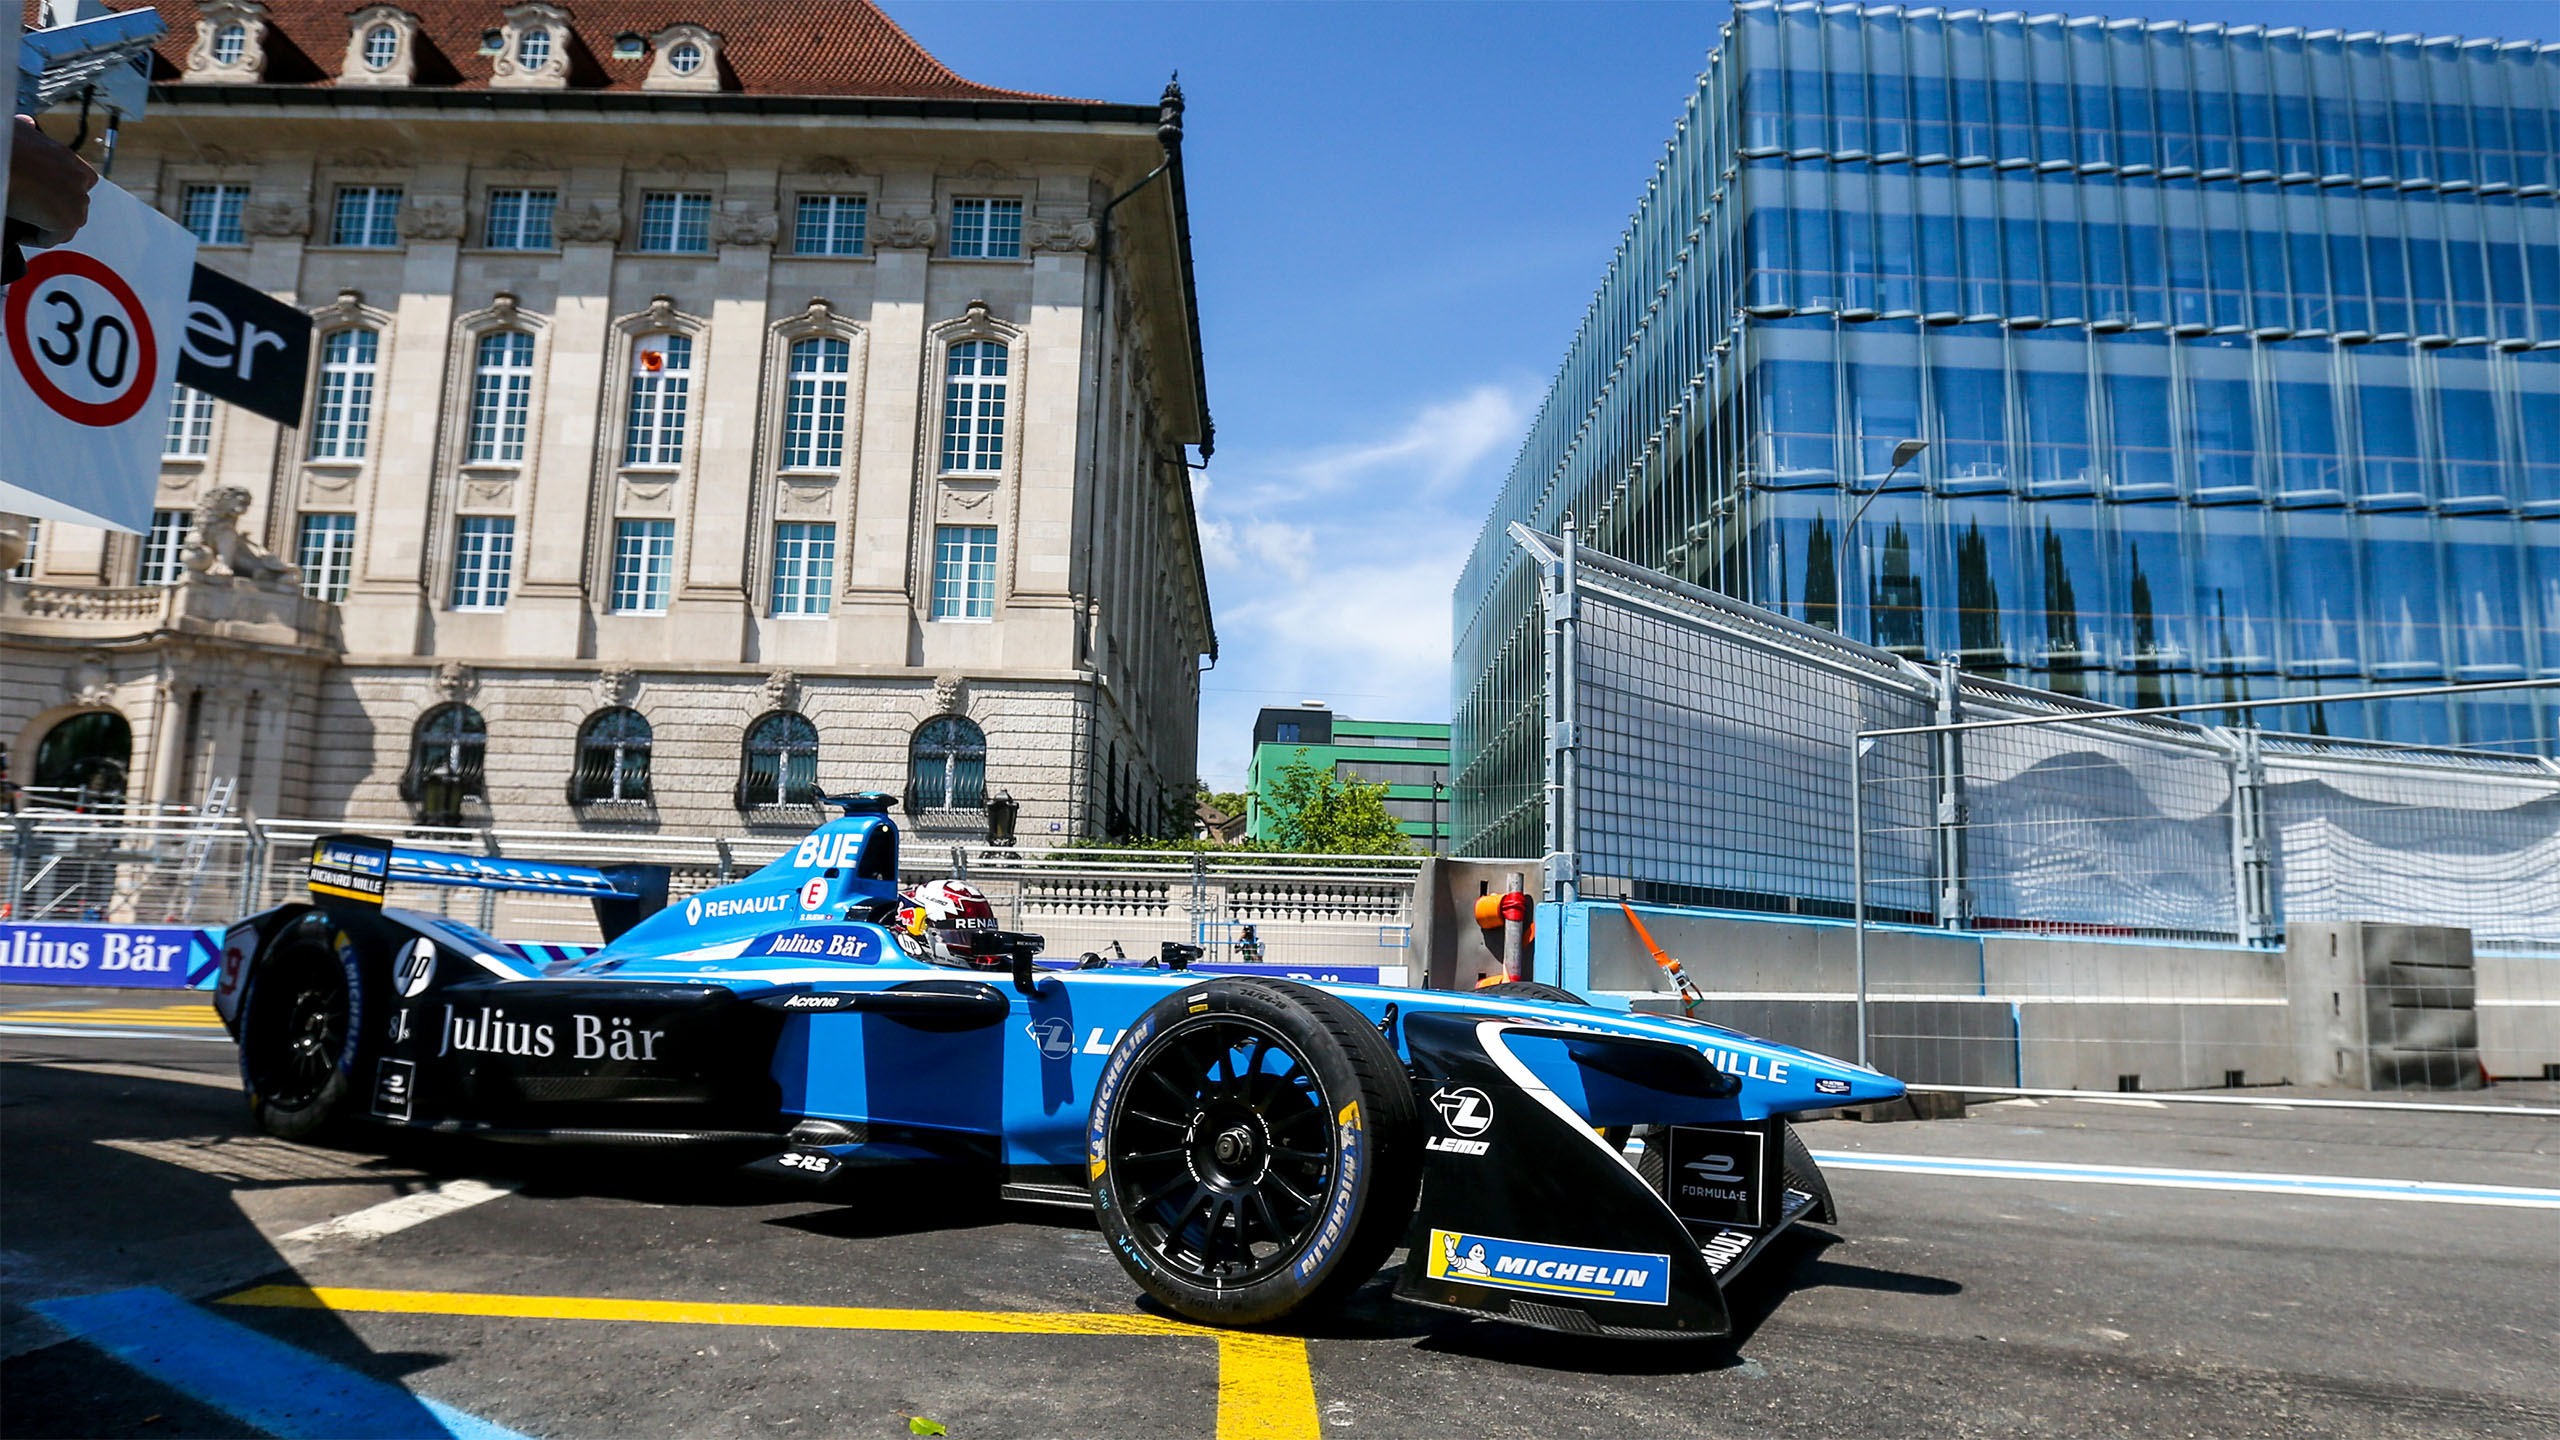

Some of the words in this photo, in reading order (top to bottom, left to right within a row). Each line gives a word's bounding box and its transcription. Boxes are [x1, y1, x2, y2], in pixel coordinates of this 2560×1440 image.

[37, 290, 129, 388] 30
[793, 834, 863, 868] BUE
[352, 877, 384, 894] MILLE
[705, 894, 789, 918] RENAULT
[98, 933, 182, 972] Bär
[766, 934, 824, 956] Julius
[826, 935, 868, 958] Bär
[784, 994, 839, 1008] Acronis
[438, 1004, 555, 1058] Julius
[573, 1014, 664, 1061] Bär
[1093, 1022, 1150, 1134] MICHELIN
[1425, 1135, 1491, 1156] LEMO
[1300, 1152, 1359, 1279] MICHELIN
[1494, 1255, 1649, 1289] MICHELIN
